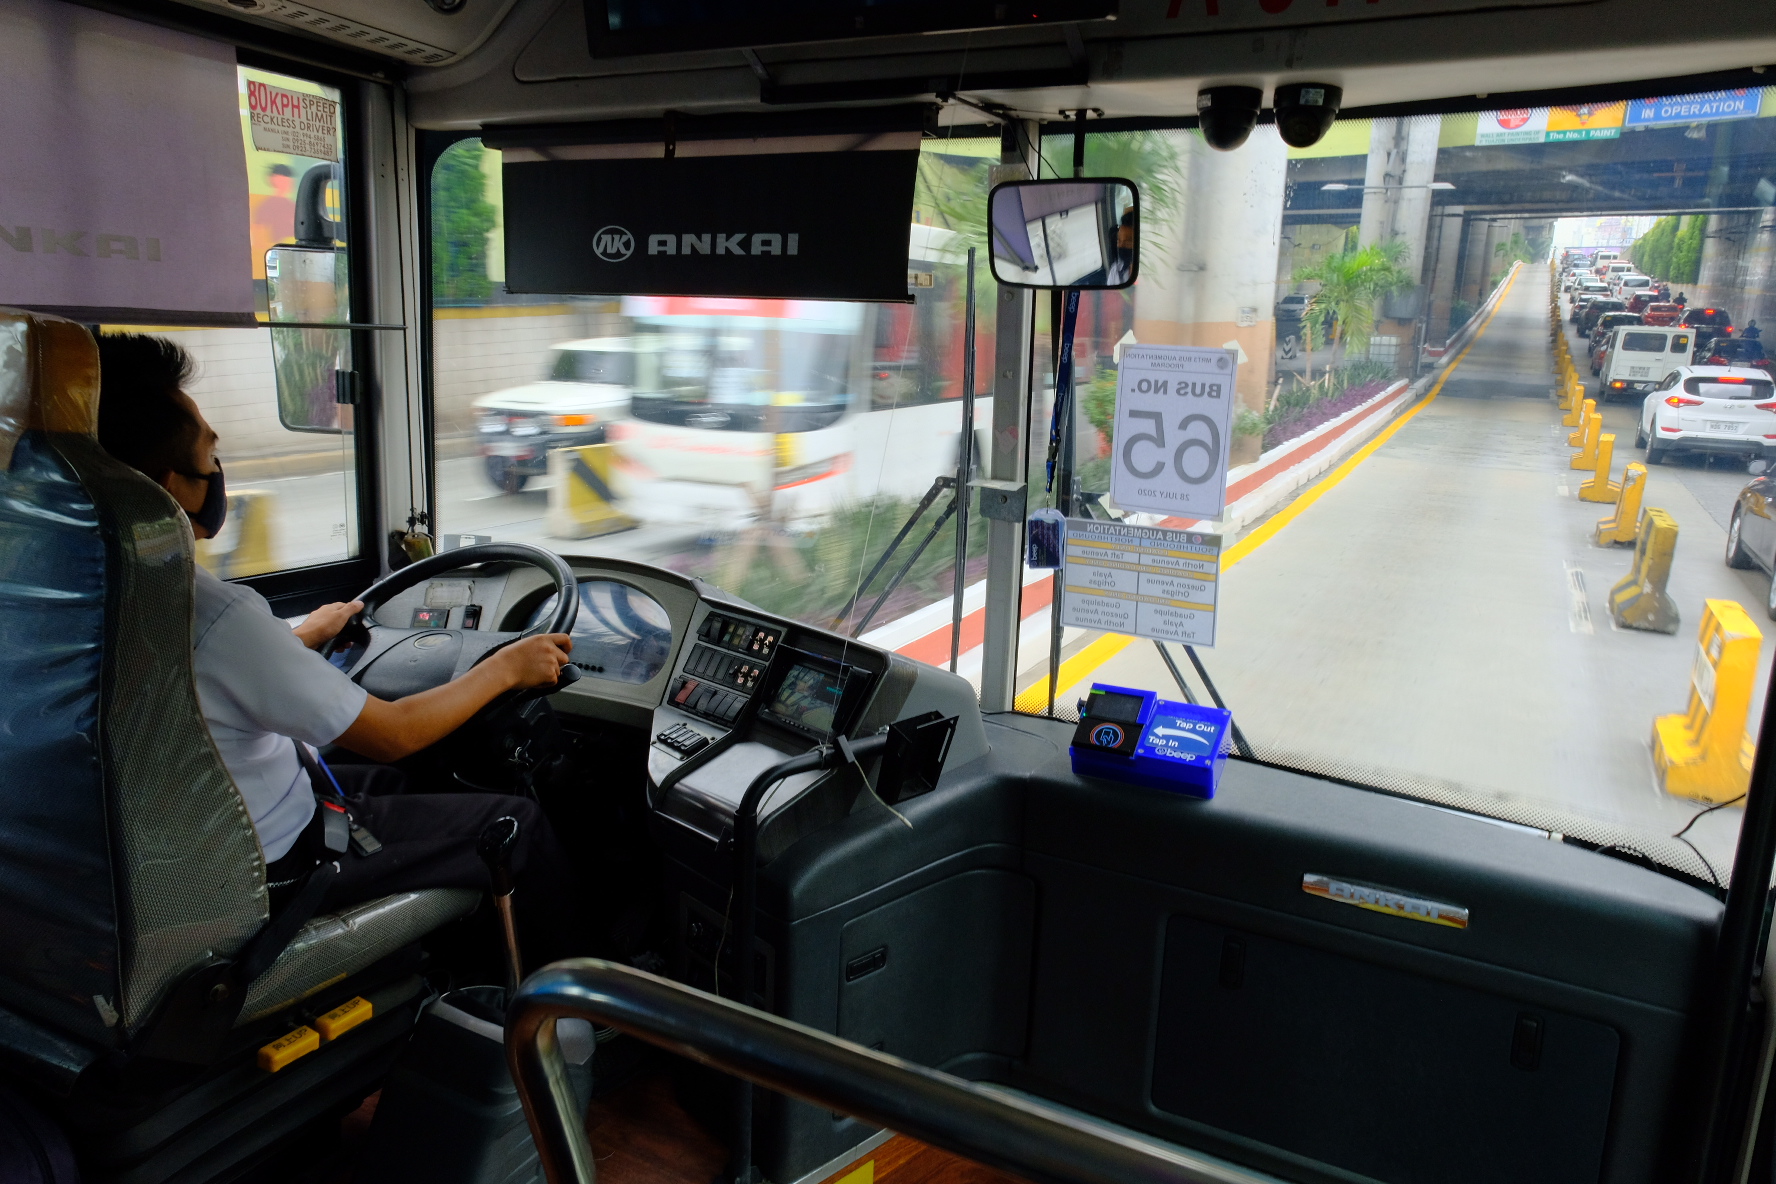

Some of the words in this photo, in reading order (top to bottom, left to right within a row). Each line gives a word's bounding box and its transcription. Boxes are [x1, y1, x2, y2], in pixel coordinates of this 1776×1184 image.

[302, 98, 336, 114] SPEED
[1641, 108, 1654, 119] IN
[1661, 100, 1745, 118] OPERATION
[251, 111, 297, 129] RECKLESS
[300, 121, 336, 136] DRIVER?
[305, 110, 334, 126] LIMIT
[1589, 128, 1616, 137] PAINT
[647, 233, 799, 255] ANKAI
[1062, 343, 1071, 363] beep
[1176, 720, 1194, 730] Tap
[1196, 723, 1216, 733] Out
[1148, 735, 1167, 746] Tap
[1168, 740, 1178, 748] In
[1166, 749, 1196, 762] beep
[1328, 881, 1439, 919] ANKAI
